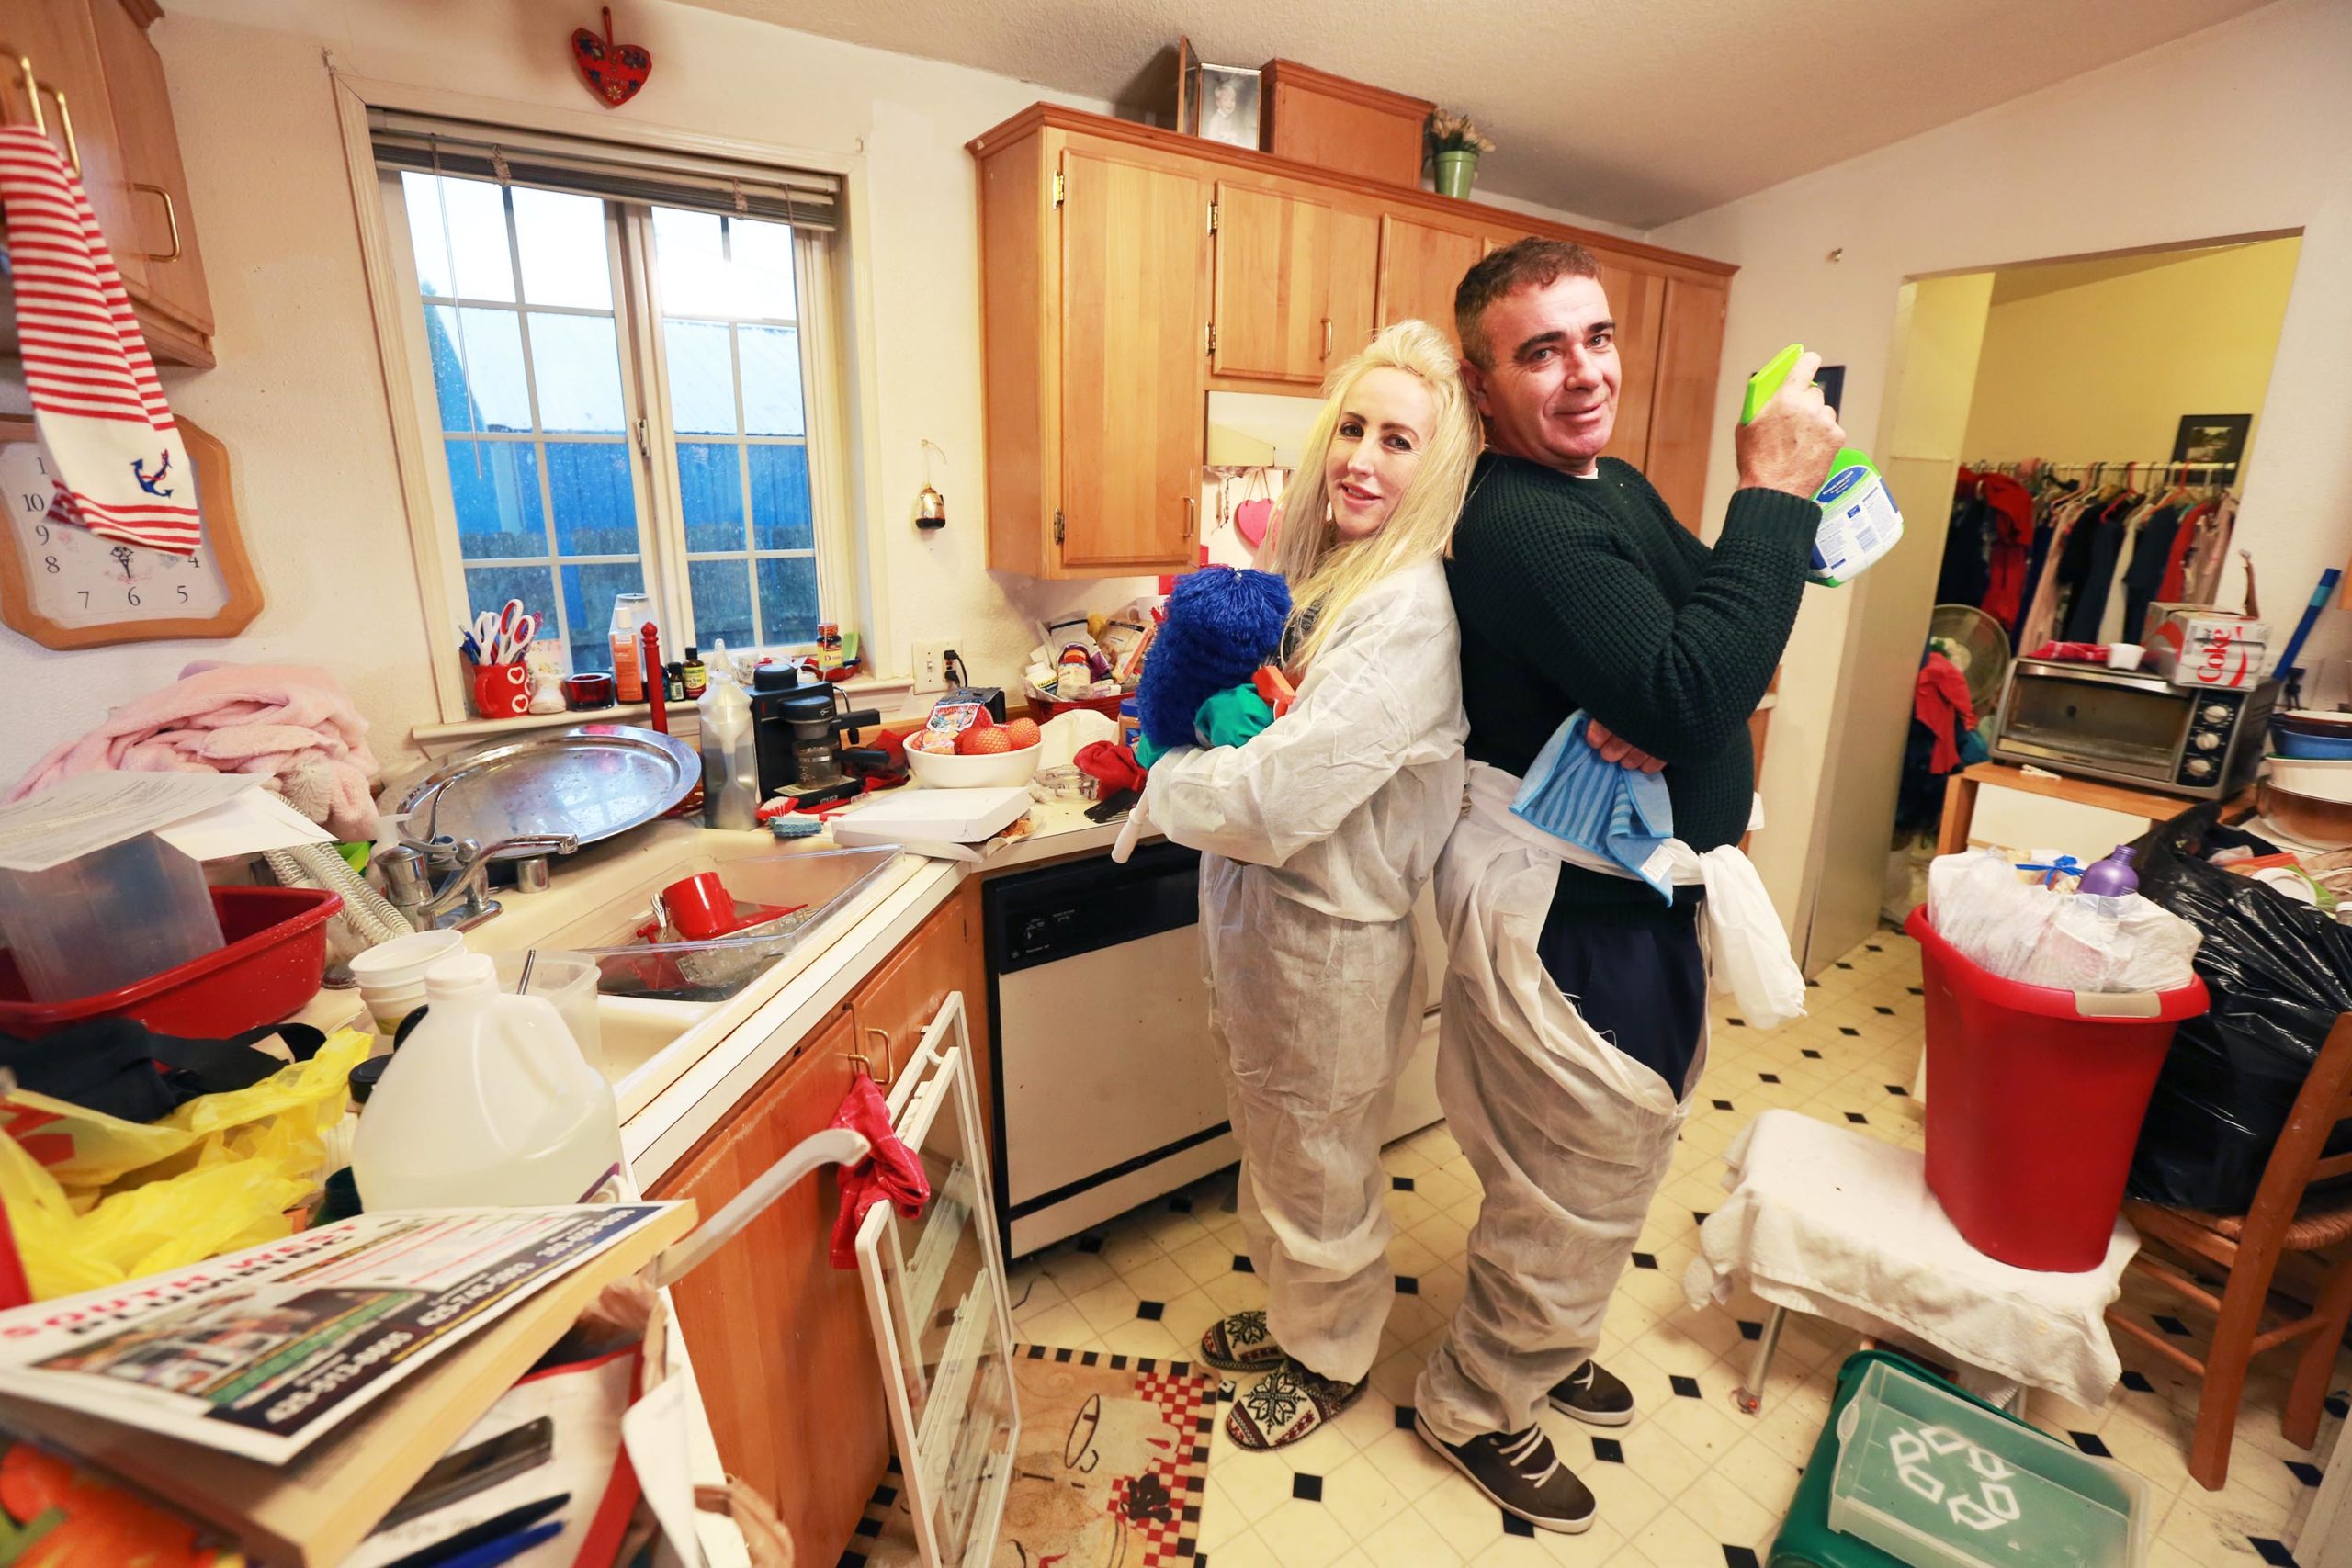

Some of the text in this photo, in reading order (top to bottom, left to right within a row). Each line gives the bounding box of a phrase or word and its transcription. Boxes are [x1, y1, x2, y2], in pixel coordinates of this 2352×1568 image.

[22, 493, 45, 513] 10
[36, 525, 50, 545] 9
[45, 556, 61, 574] 8
[187, 556, 200, 568] 4
[77, 591, 90, 609] 7
[128, 587, 141, 606] 6
[176, 585, 188, 604] 5
[2197, 628, 2232, 682] Coke
[1, 1224, 356, 1337] SOUTH WEST
[68, 1235, 354, 1336] PLUMBING
